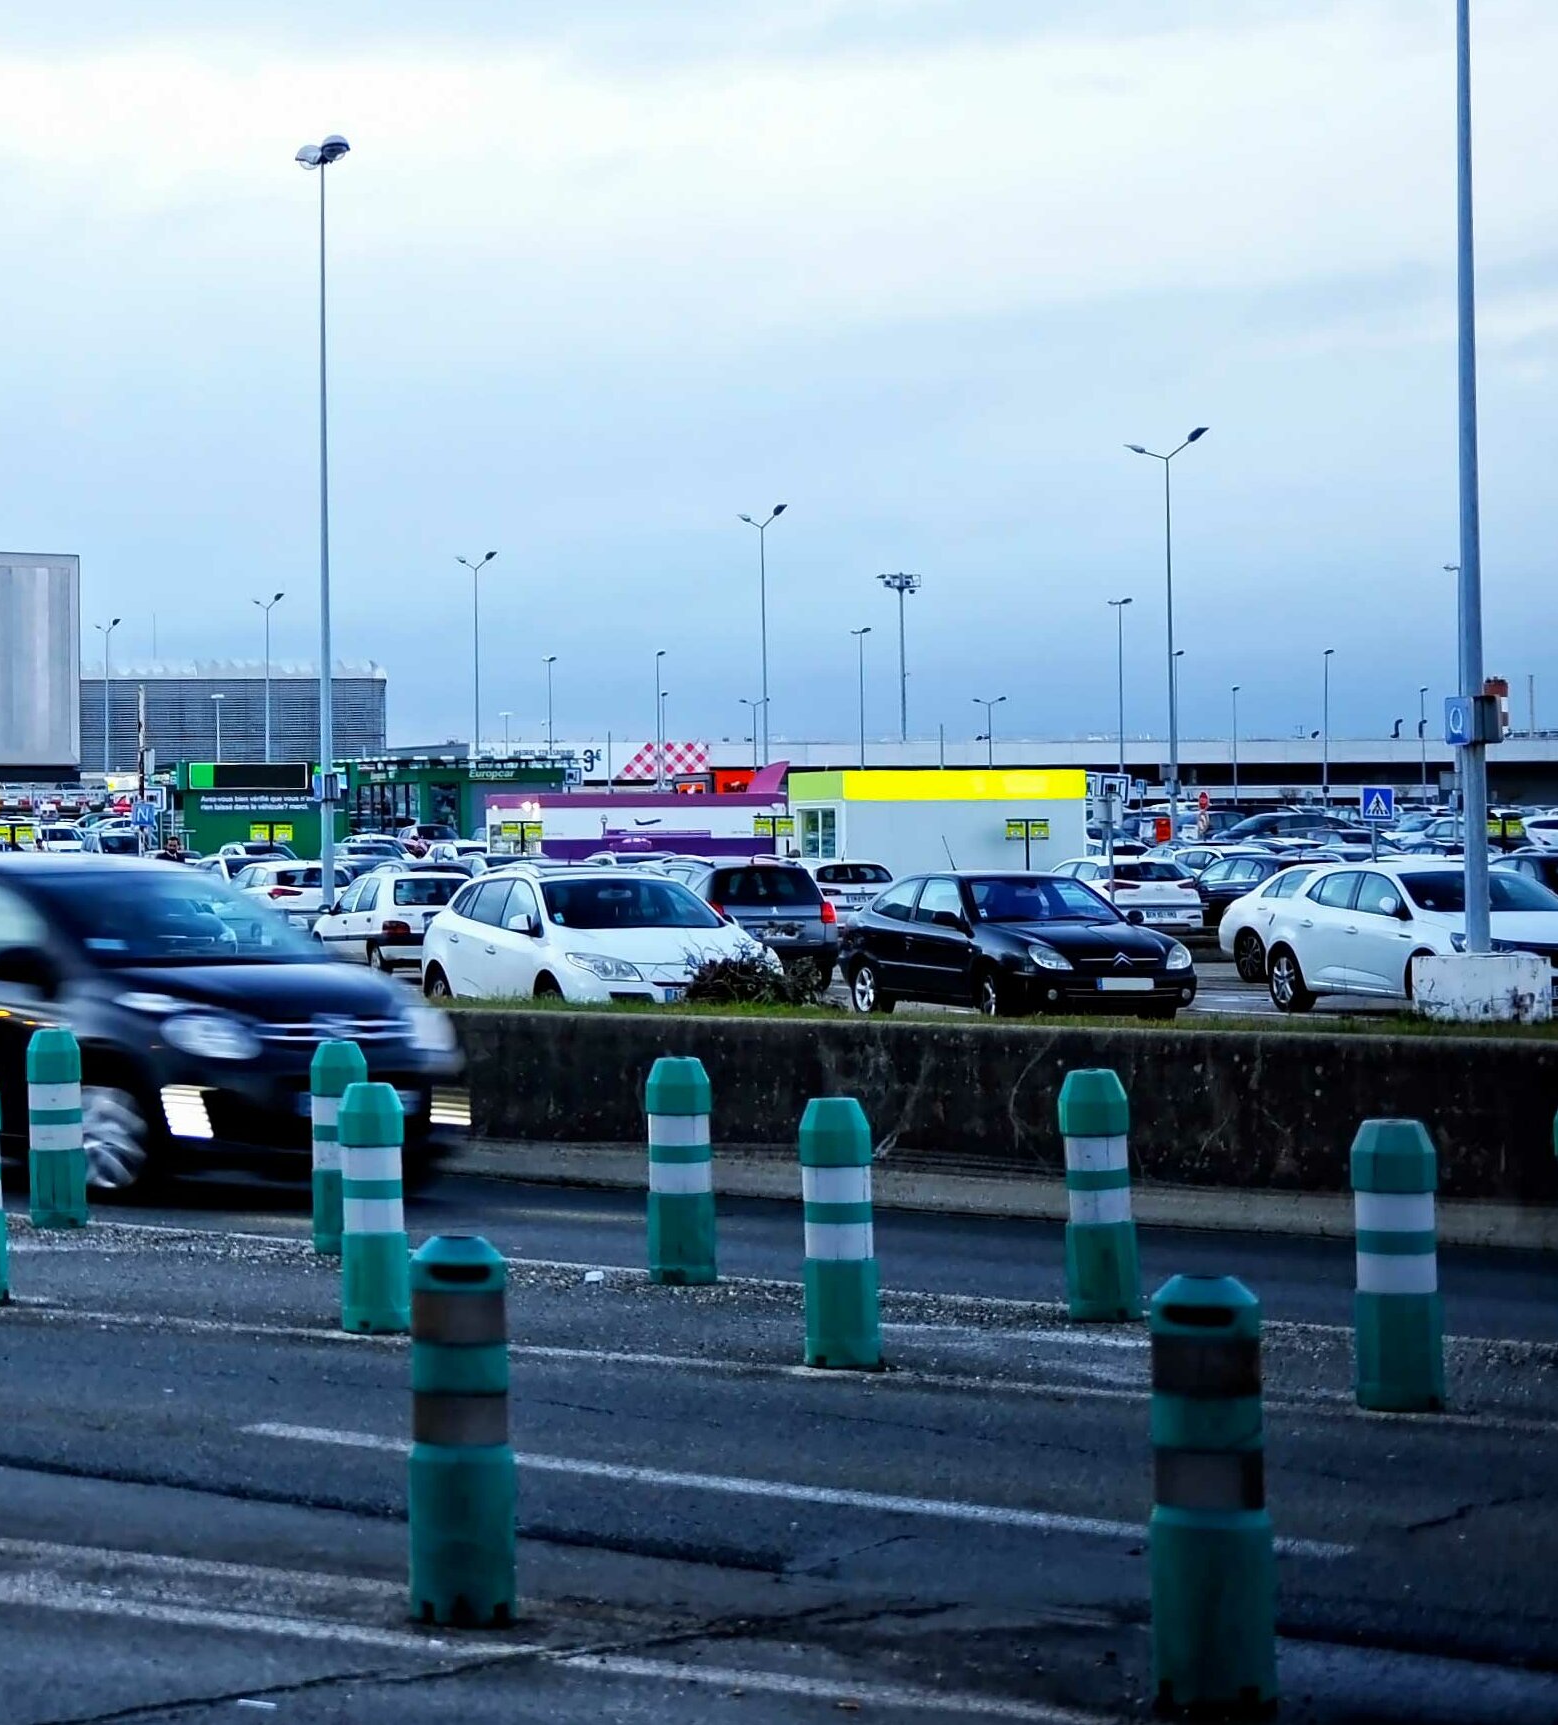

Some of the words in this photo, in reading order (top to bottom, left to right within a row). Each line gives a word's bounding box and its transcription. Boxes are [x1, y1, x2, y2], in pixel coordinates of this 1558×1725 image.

[1449, 706, 1463, 734] Q
[468, 769, 515, 780] Europcar
[200, 795, 233, 803] Avez-vous
[234, 795, 249, 803] bien
[270, 796, 282, 804] que
[200, 803, 213, 811] rien
[214, 803, 233, 811] laissé
[234, 803, 250, 811] dans
[251, 803, 257, 811] le
[137, 807, 149, 822] N
